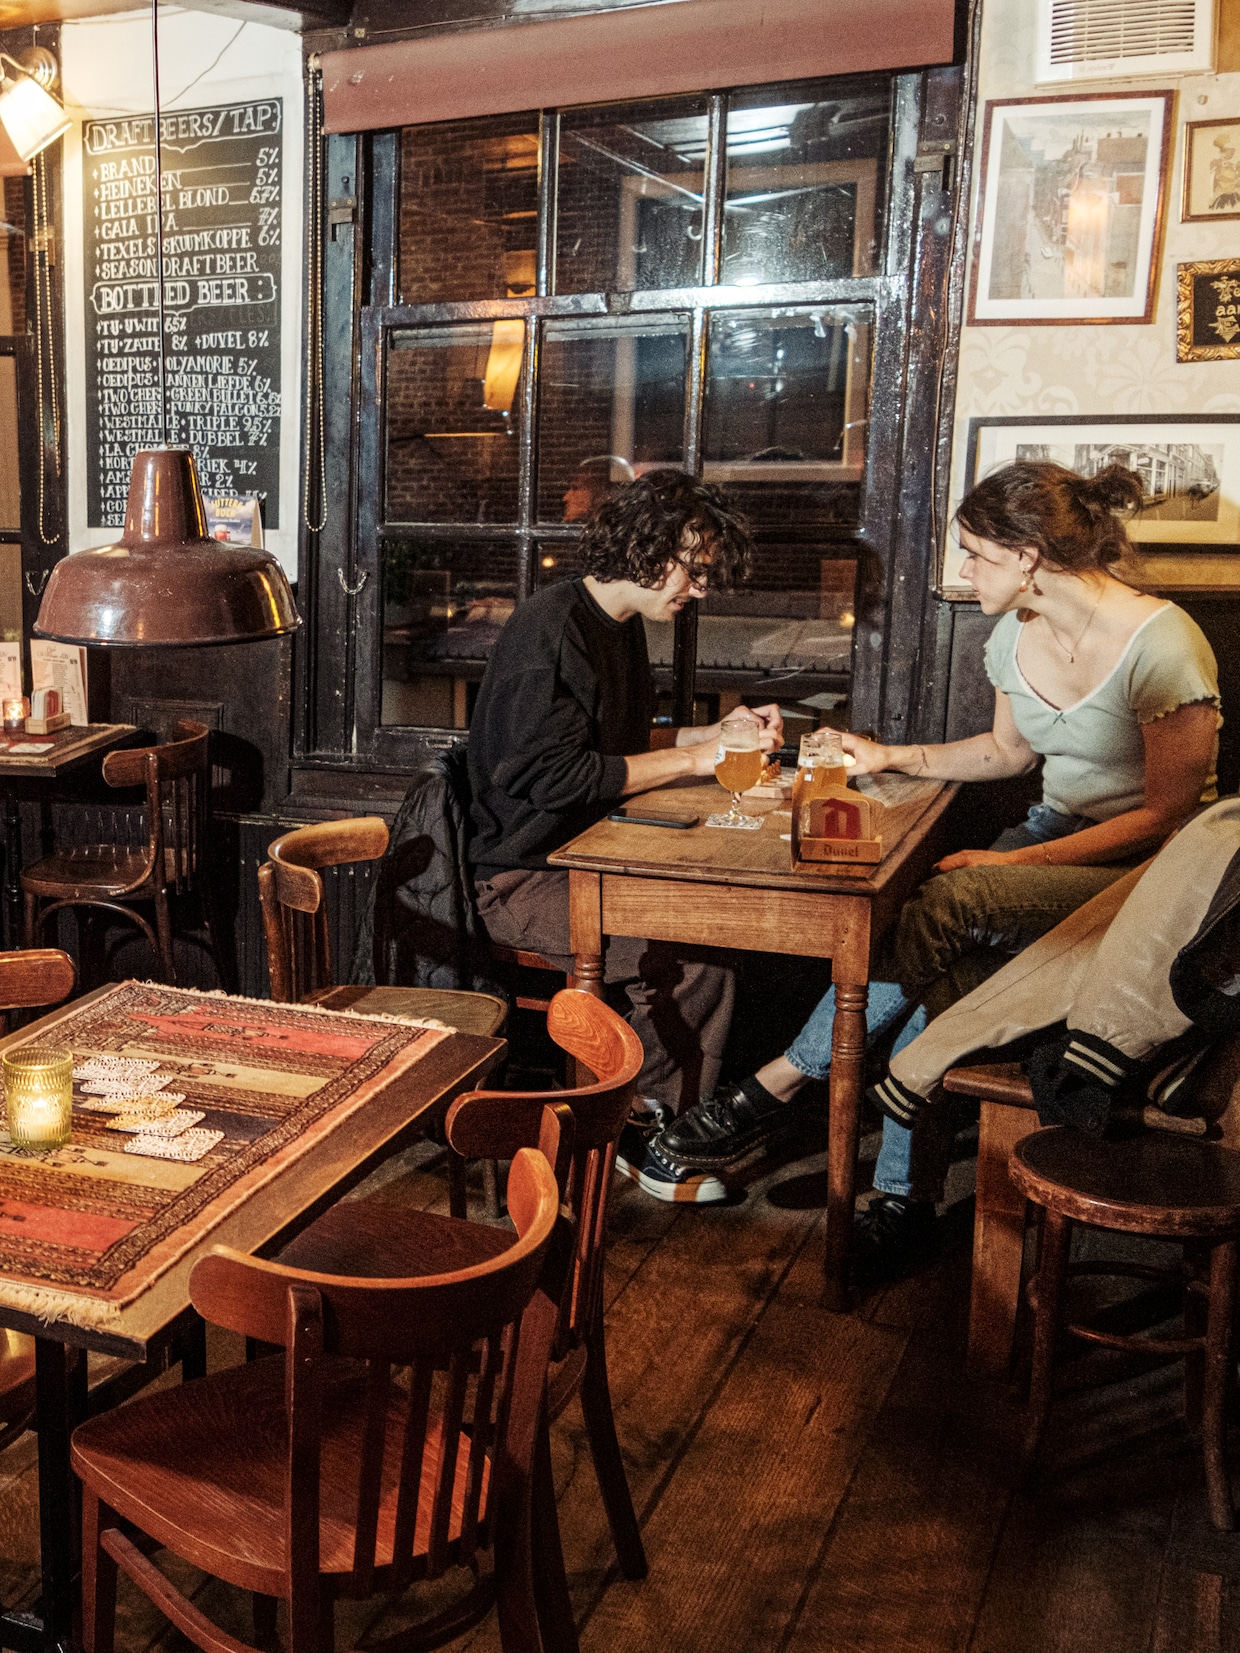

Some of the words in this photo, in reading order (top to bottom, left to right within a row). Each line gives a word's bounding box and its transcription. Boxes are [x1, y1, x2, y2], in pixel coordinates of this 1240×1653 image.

[92, 119, 152, 151] DRAFT
[100, 156, 156, 181] BRAND
[256, 147, 279, 166] 5%
[100, 172, 182, 201] HEINEKEN
[256, 167, 278, 185] 5%
[179, 187, 229, 210] BLOND
[101, 218, 139, 239] GAIA
[101, 237, 156, 260] TEXELS
[258, 226, 280, 246] 6%
[101, 258, 158, 280] SEASON
[162, 254, 214, 276] DRAFT
[216, 252, 259, 274] BEER
[100, 281, 190, 312] BOTTLED
[197, 278, 251, 304] BEER
[1216, 303, 1240, 316] aa
[171, 334, 188, 351] 8%
[202, 331, 246, 349] DUVEL
[248, 330, 269, 348] 8%
[102, 355, 152, 375] OEDIPUS
[158, 355, 233, 375] OLYAMORIE
[237, 357, 258, 376] 5%
[102, 373, 153, 389] OEDIPUS
[158, 373, 206, 388] ANNEN
[208, 374, 252, 391] LIEFDE
[254, 376, 271, 393] 6%
[103, 388, 128, 403] TWO
[171, 387, 211, 401] GREEN
[213, 388, 256, 404] BULLET
[103, 403, 129, 415] TWO
[171, 401, 212, 416] FUNKY
[213, 403, 260, 417] FALCON
[188, 416, 240, 431] TRIPLE
[104, 429, 179, 443] WESTMALE
[189, 430, 244, 447] DUBBEL
[104, 443, 124, 457] LA
[193, 445, 209, 458] 8%
[197, 459, 231, 473] RIEK
[215, 474, 233, 488] 2%
[823, 843, 859, 857] Duvel
